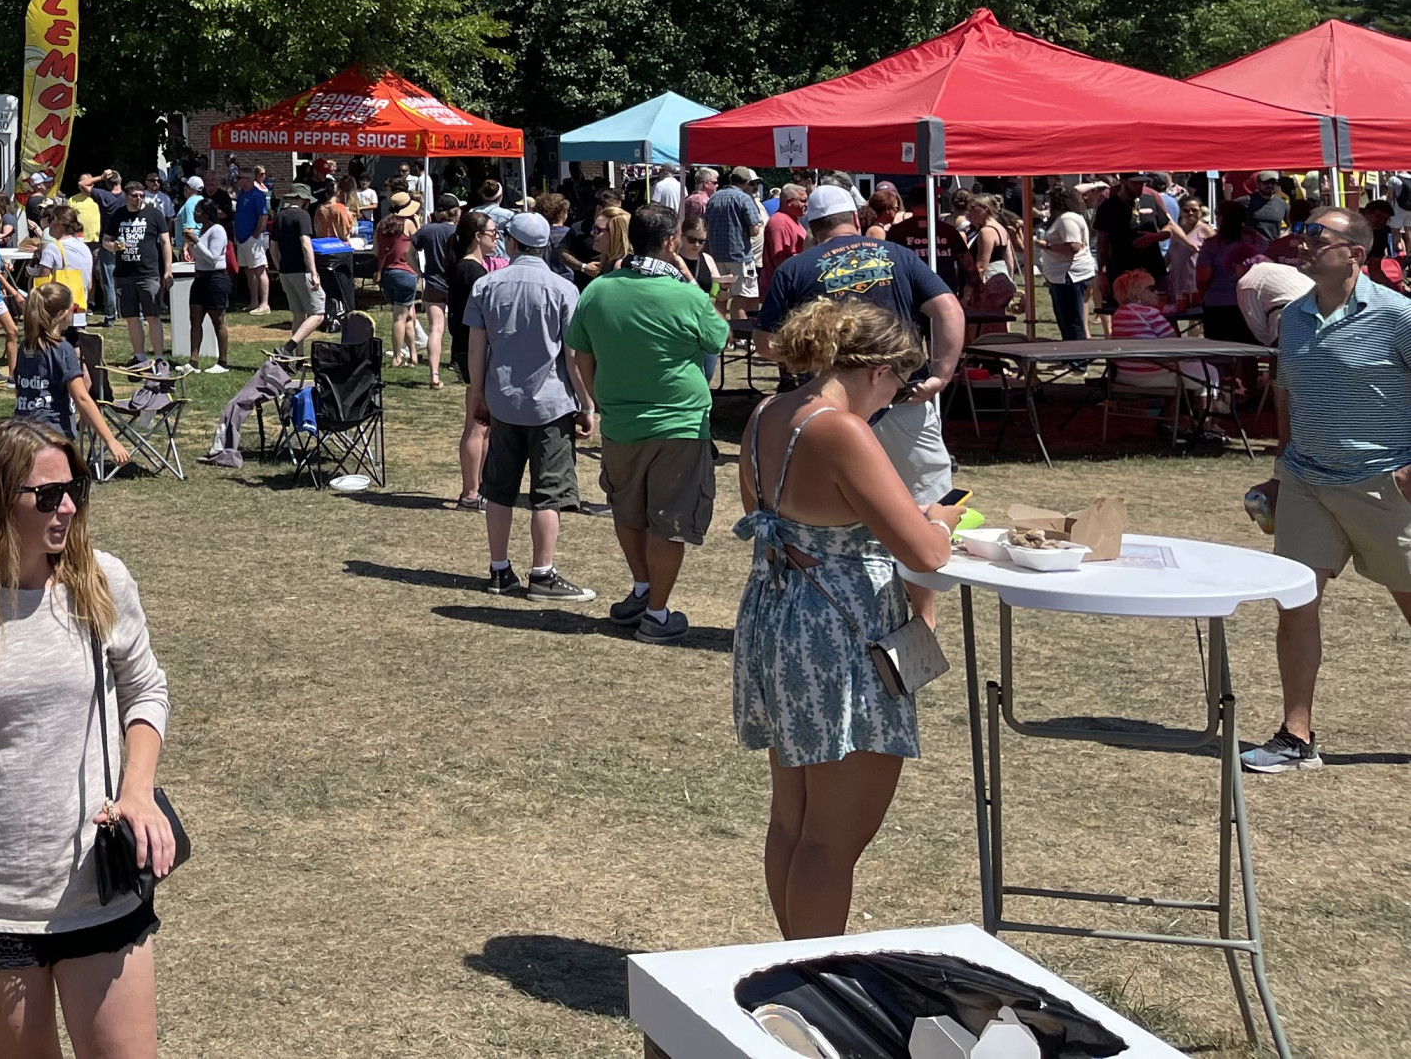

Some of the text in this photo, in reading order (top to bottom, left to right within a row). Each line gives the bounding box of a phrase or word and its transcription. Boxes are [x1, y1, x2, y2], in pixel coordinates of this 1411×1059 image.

[311, 93, 389, 110] BANANA
[309, 103, 380, 118] PEPPER
[230, 129, 407, 149] BANANA PEPPER SAUCE
[906, 236, 948, 246] Fooie
[828, 268, 891, 288] COSTA
